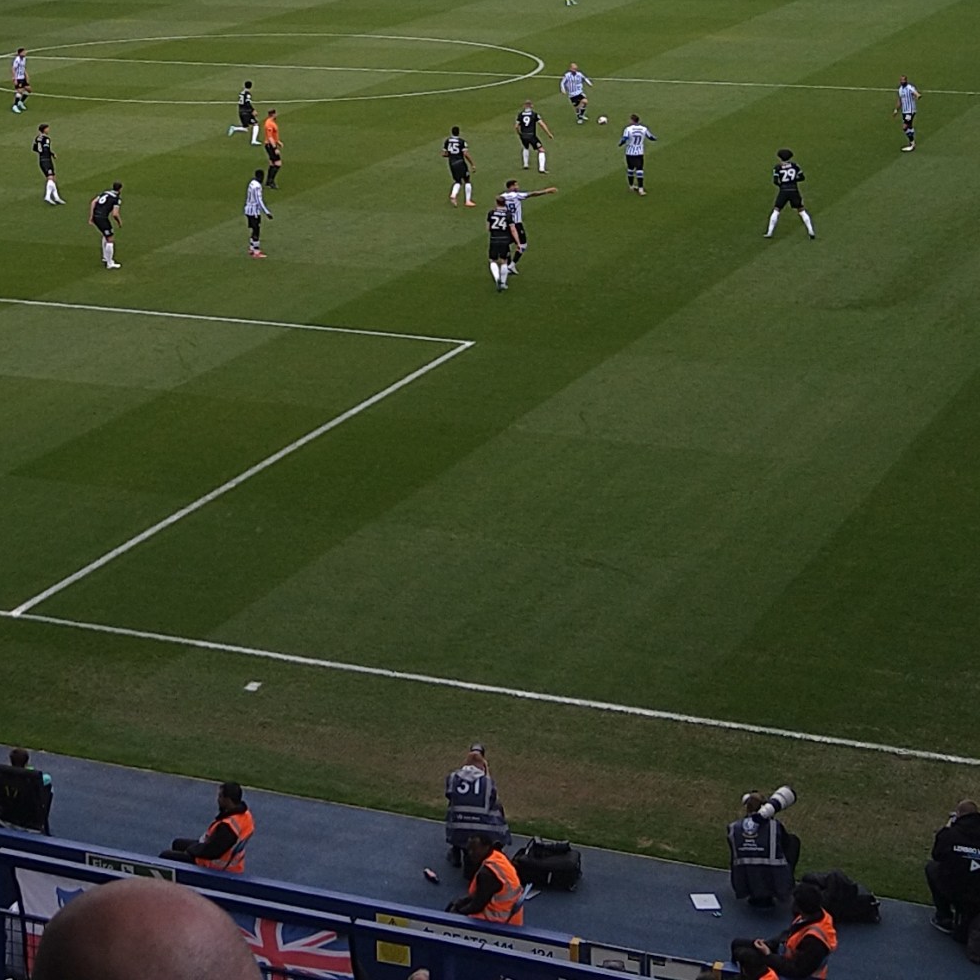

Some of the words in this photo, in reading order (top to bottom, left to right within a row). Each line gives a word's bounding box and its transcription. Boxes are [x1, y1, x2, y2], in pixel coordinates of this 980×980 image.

[523, 115, 531, 126] 9
[447, 142, 460, 154] 45
[779, 168, 796, 182] 29
[99, 194, 108, 204] 6
[490, 215, 507, 230] 24
